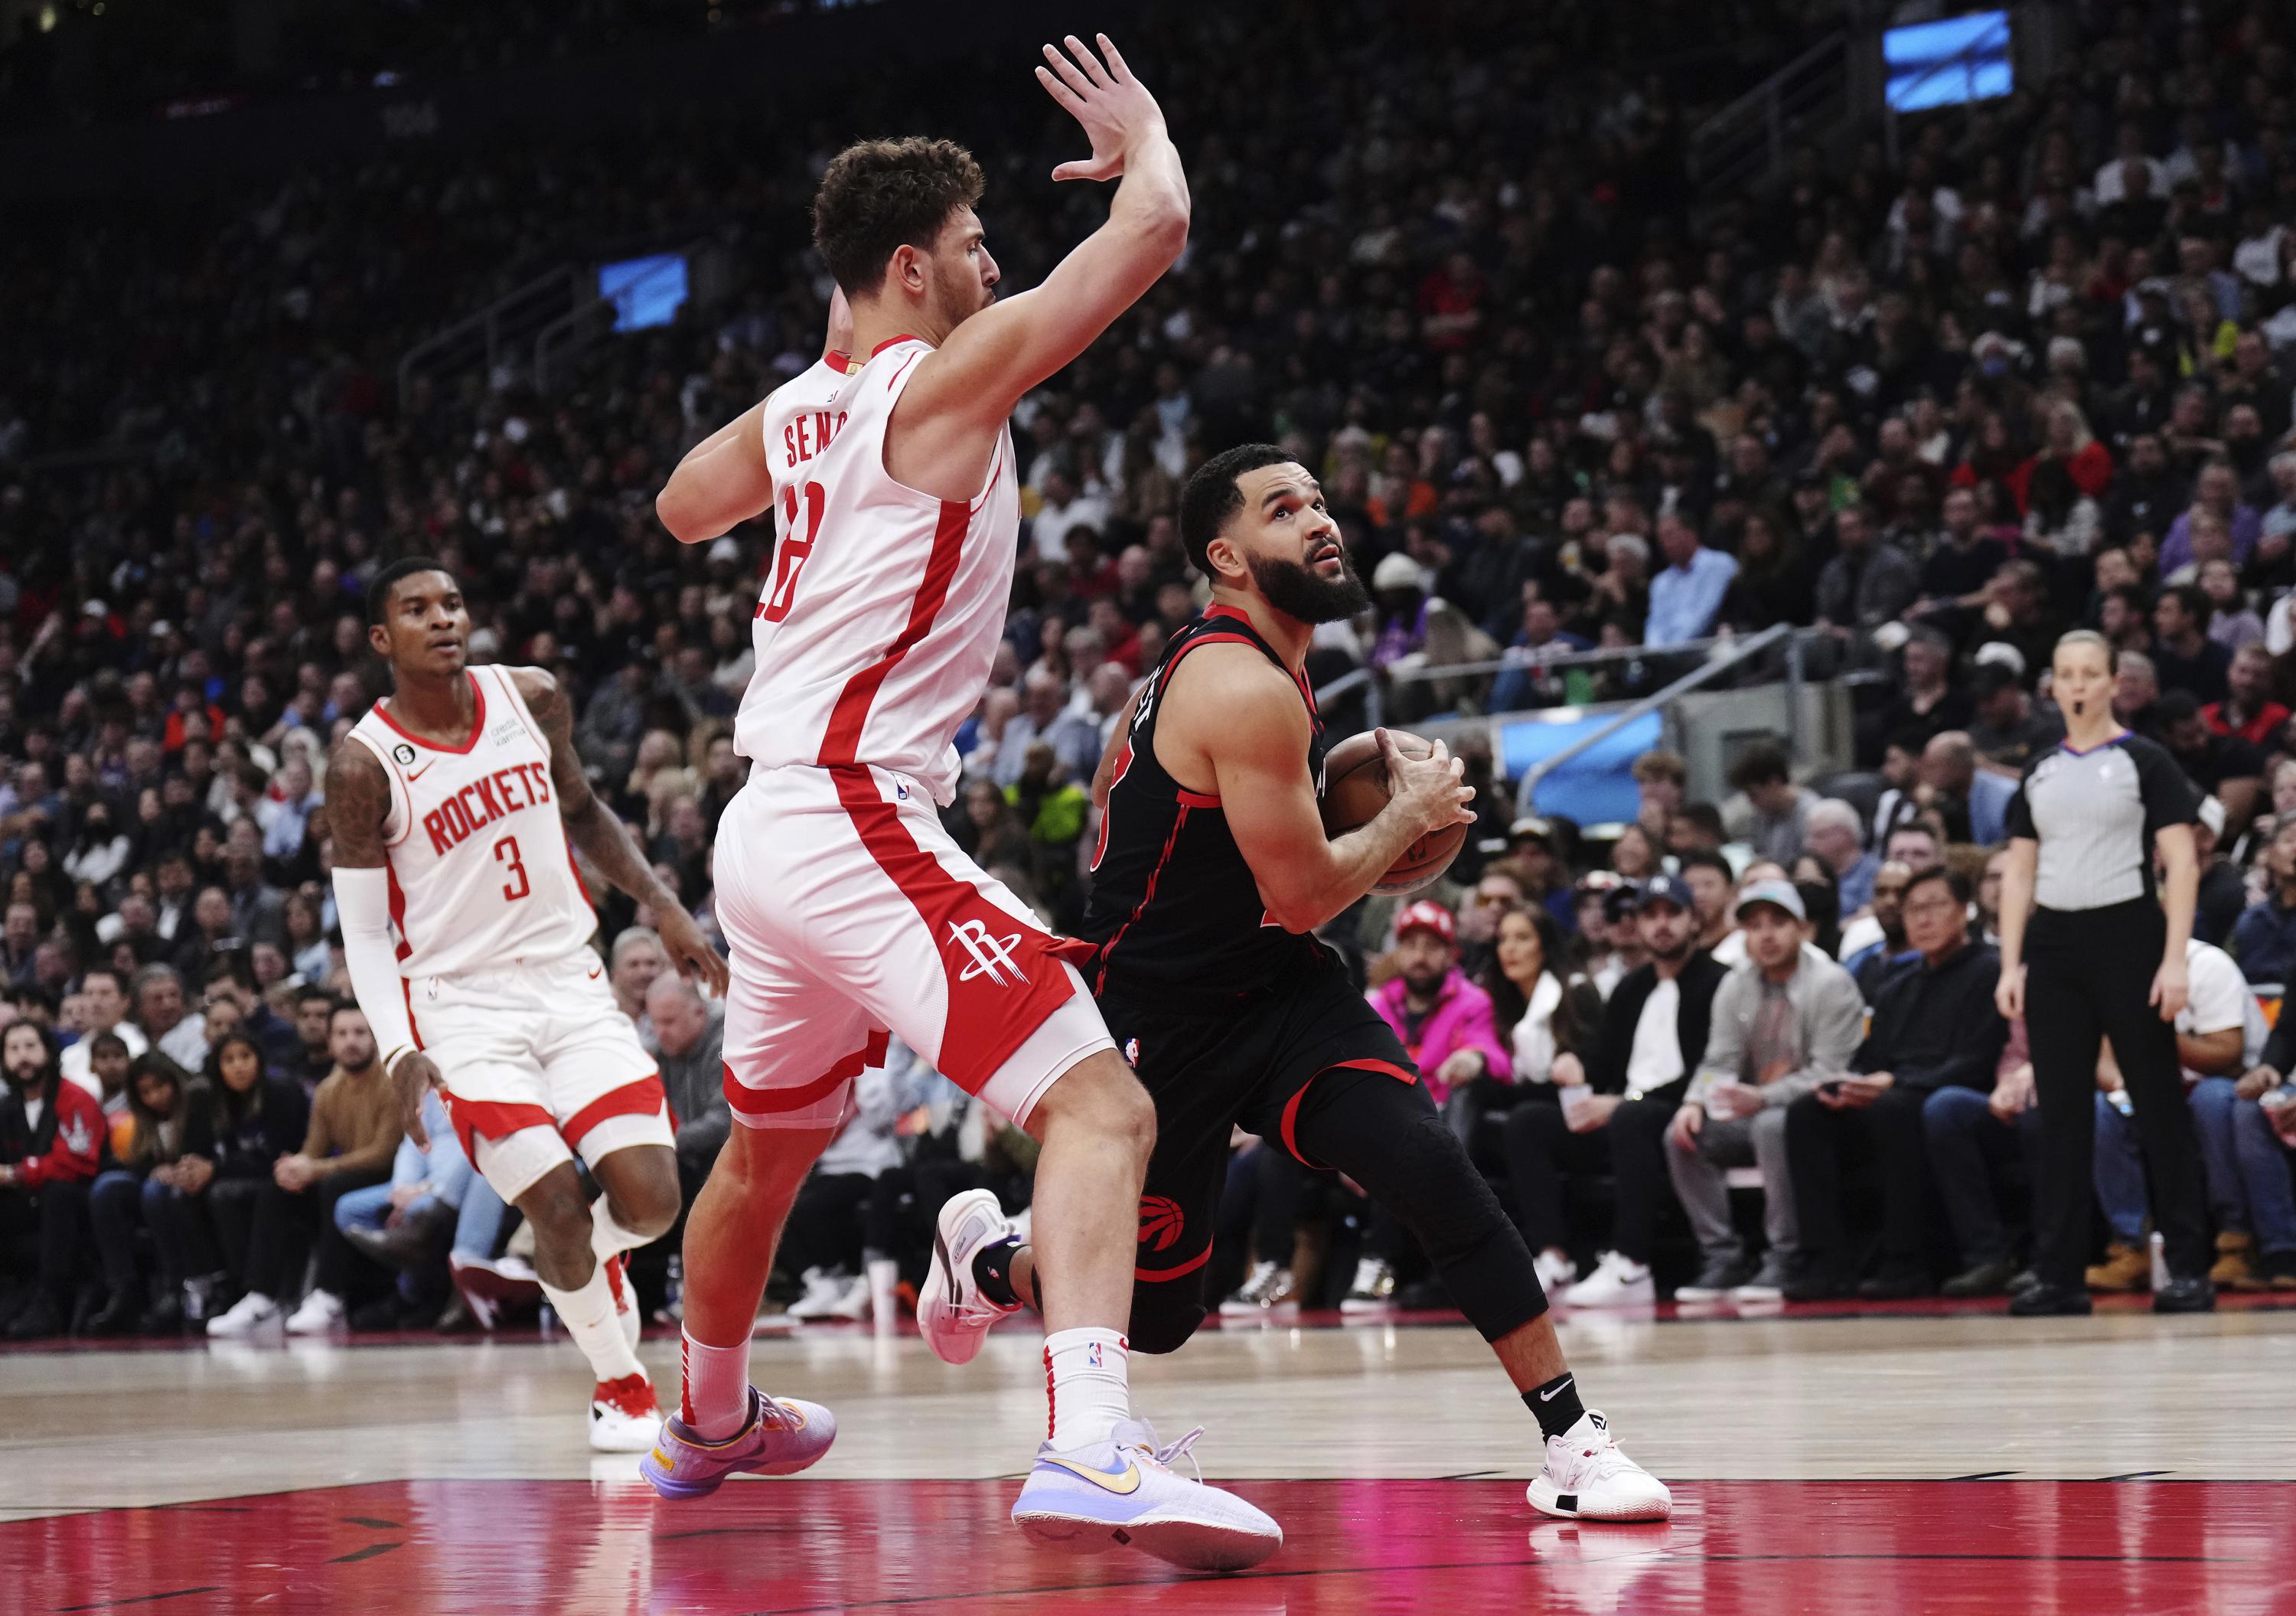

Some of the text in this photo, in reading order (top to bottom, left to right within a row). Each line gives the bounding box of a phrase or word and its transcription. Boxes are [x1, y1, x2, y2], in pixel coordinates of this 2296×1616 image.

[754, 481, 826, 623] 8
[395, 745, 415, 764] 6
[422, 762, 550, 857] ROCKETS
[494, 835, 530, 903] 3
